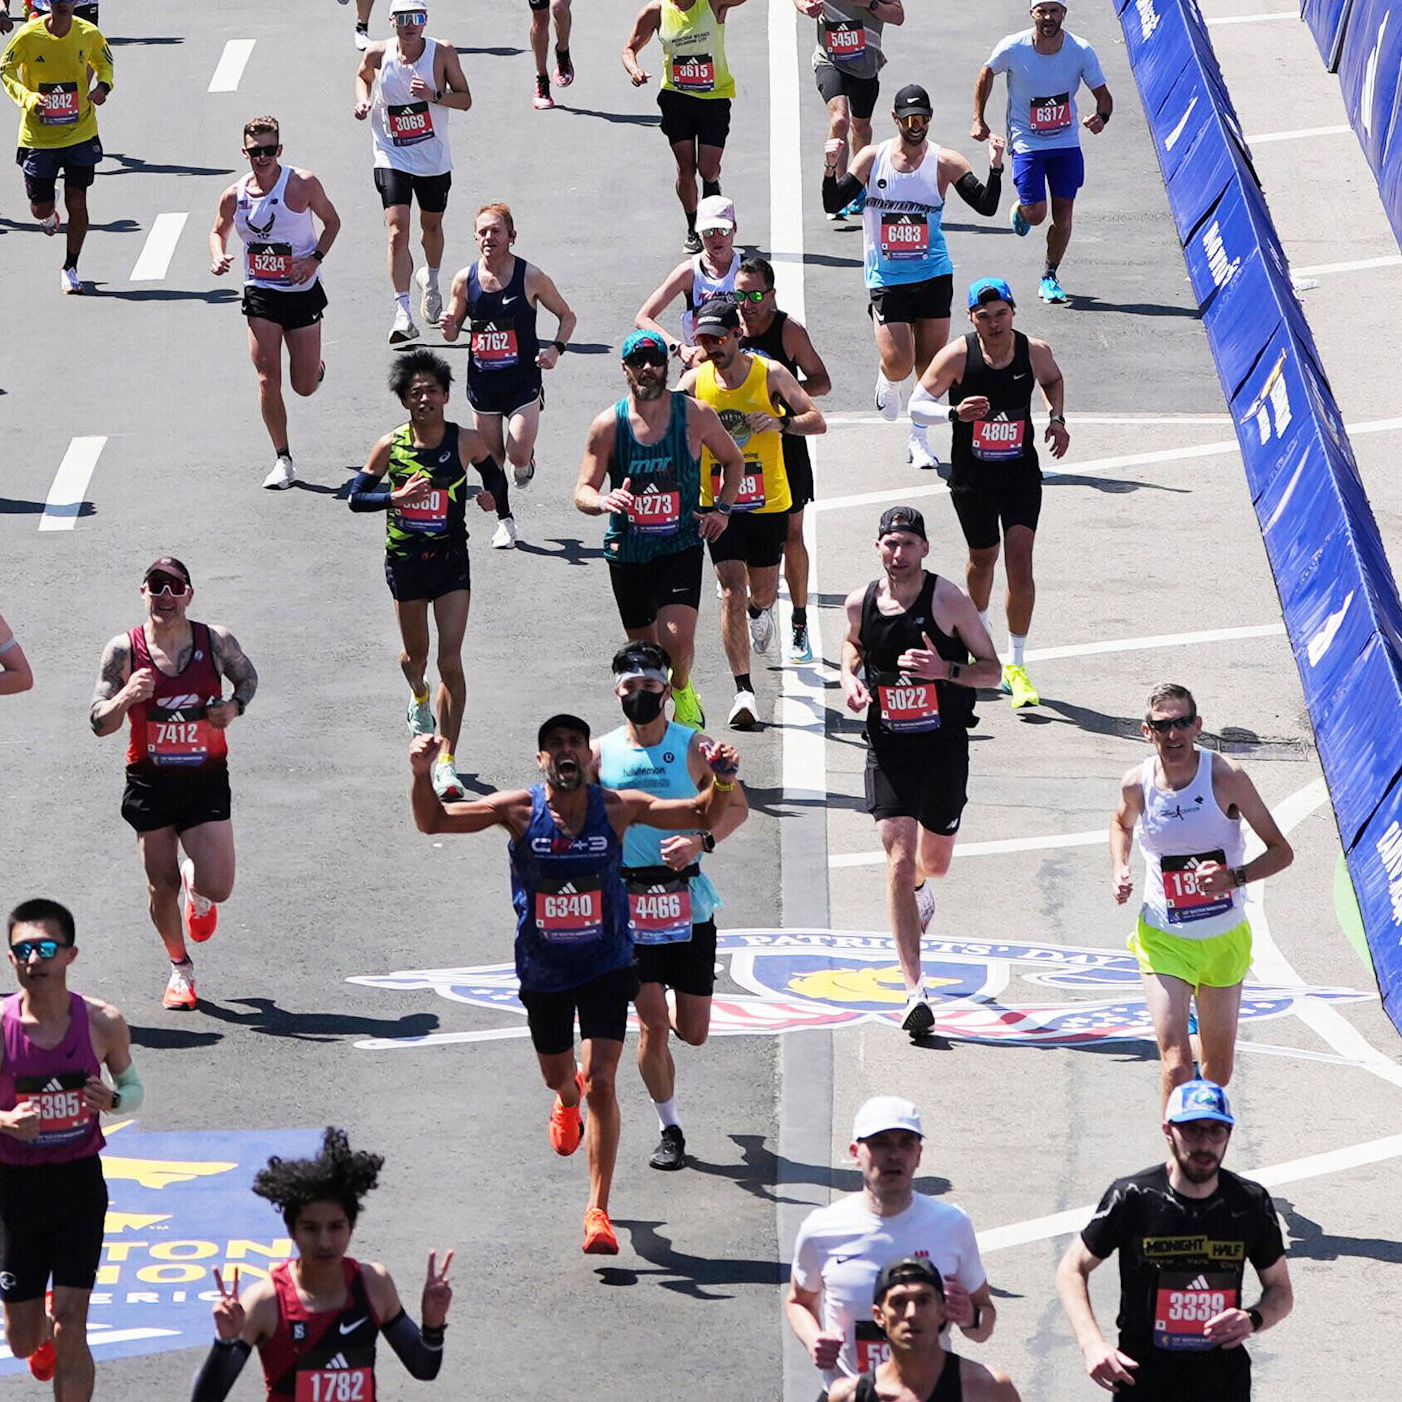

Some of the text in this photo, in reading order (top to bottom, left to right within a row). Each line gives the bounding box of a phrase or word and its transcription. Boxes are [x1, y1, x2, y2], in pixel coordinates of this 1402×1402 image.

[831, 32, 858, 45] 5450
[679, 63, 708, 79] 3615
[396, 114, 426, 132] 3068
[1036, 105, 1065, 123] 6317
[888, 225, 921, 243] 6483
[255, 255, 286, 272] 5234
[981, 423, 1017, 441] 4805
[634, 495, 672, 515] 4273
[885, 687, 929, 709] 5022
[156, 723, 198, 743] 7412
[545, 895, 592, 918] 6340
[636, 896, 681, 918] 4466
[1018, 948, 1130, 967] DAY
[1146, 1238, 1243, 1257] MIDNIGHT HALF
[1169, 1293, 1225, 1321] 3339
[310, 1373, 364, 1402] 1782
